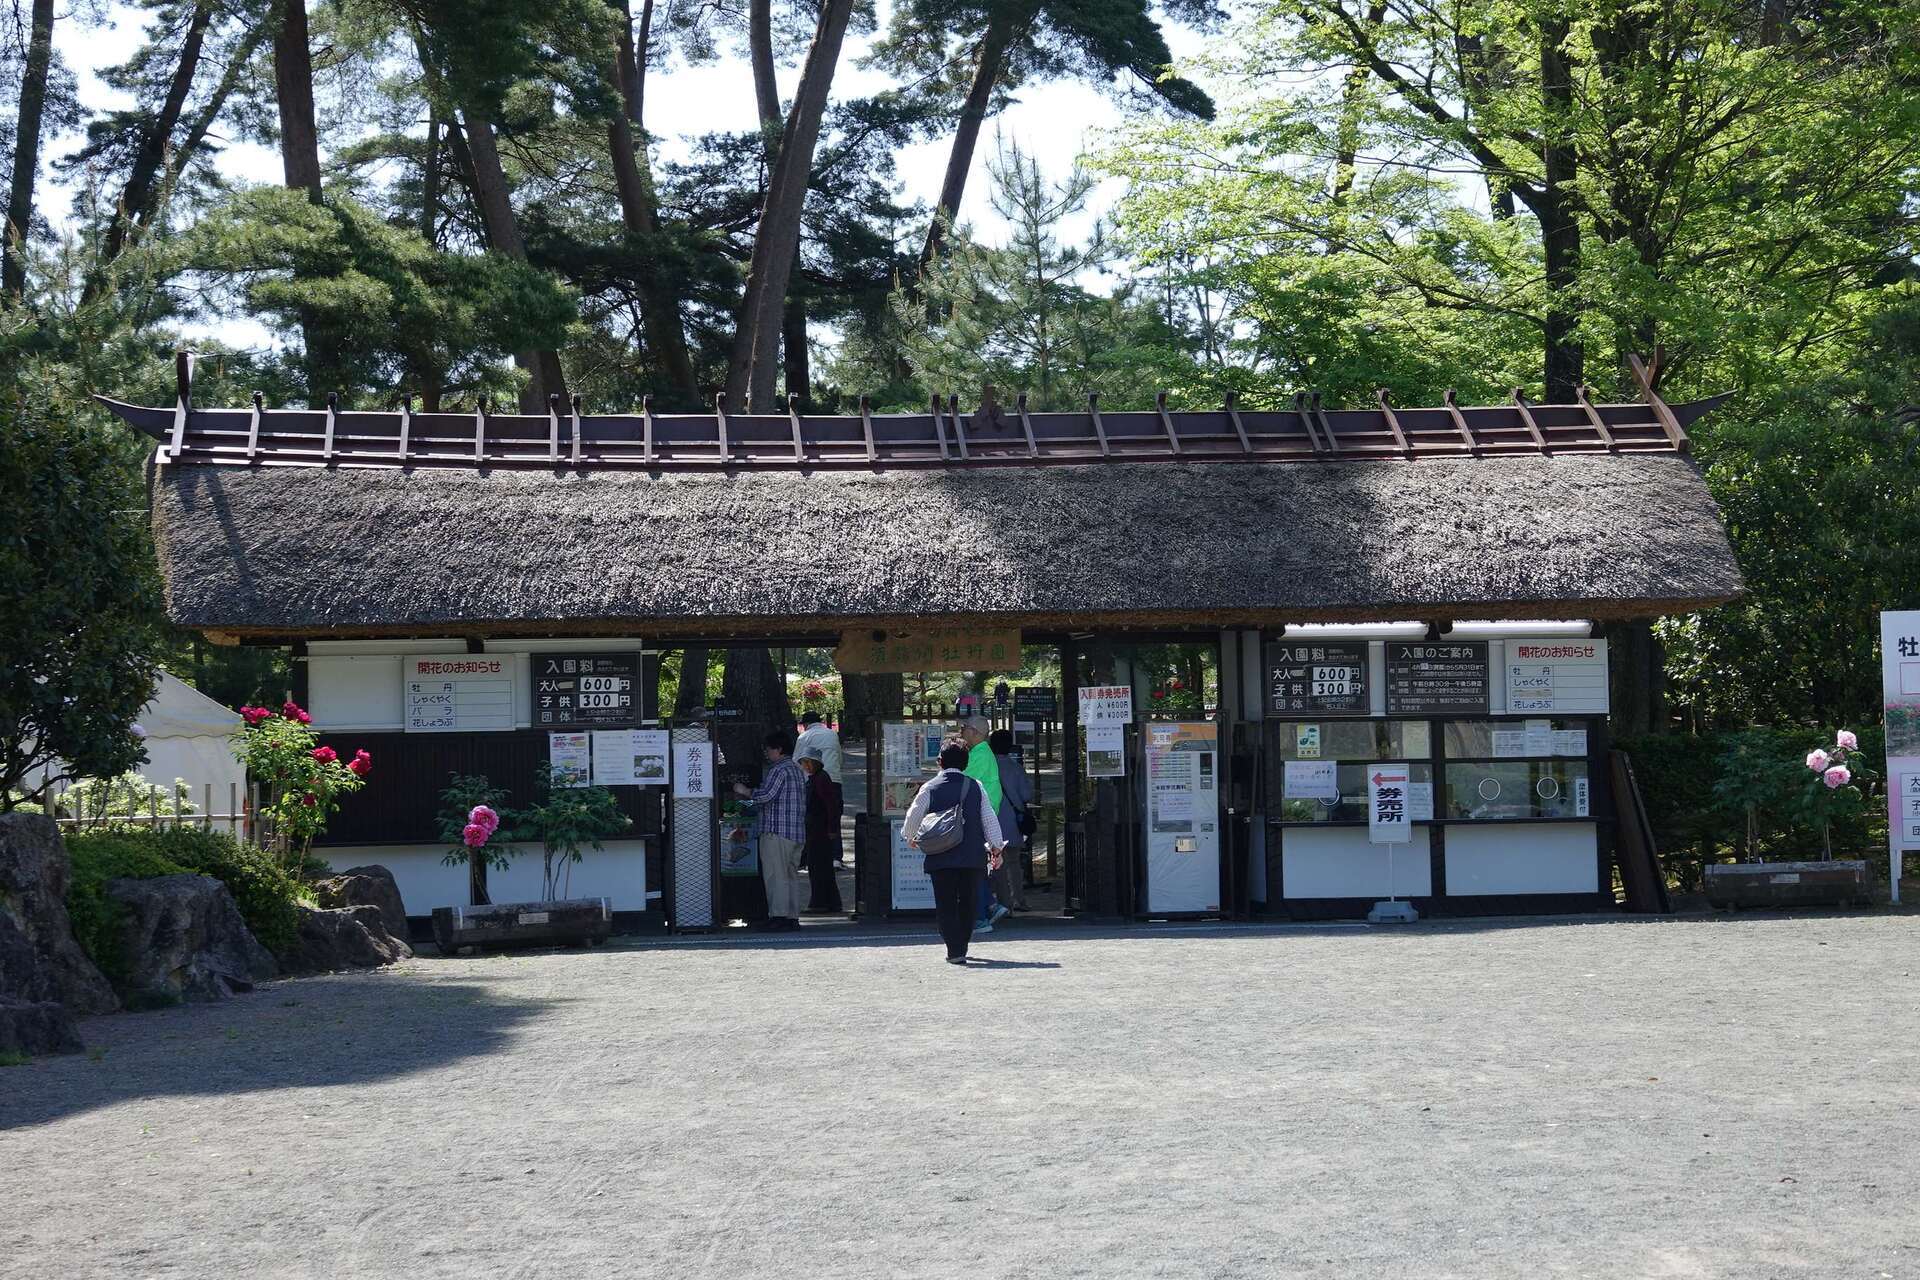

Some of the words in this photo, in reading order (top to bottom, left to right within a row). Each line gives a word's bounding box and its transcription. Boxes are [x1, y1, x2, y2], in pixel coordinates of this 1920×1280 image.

[1518, 646, 1595, 658] 開花のお知らせ
[1898, 636, 1920, 657] 牡
[1280, 647, 1325, 661] 入園料
[1401, 647, 1473, 658] 入園のご案内
[417, 661, 502, 674] 開花のお知らせ
[545, 659, 593, 673] 入園料
[1273, 668, 1291, 679] 大人
[539, 680, 559, 692] 大人
[1514, 678, 1550, 687] しゃくやく
[1274, 684, 1304, 695] 子供
[412, 695, 452, 704] しゃくやく
[539, 696, 572, 707] 子供
[1276, 698, 1304, 709] 団体
[1514, 700, 1552, 708] 花しょうぶ
[411, 706, 453, 715] バラ
[541, 711, 572, 722] 団体
[412, 719, 454, 727] 花しょうぶ
[687, 747, 703, 793] 券売機
[1376, 787, 1404, 822] 券売所
